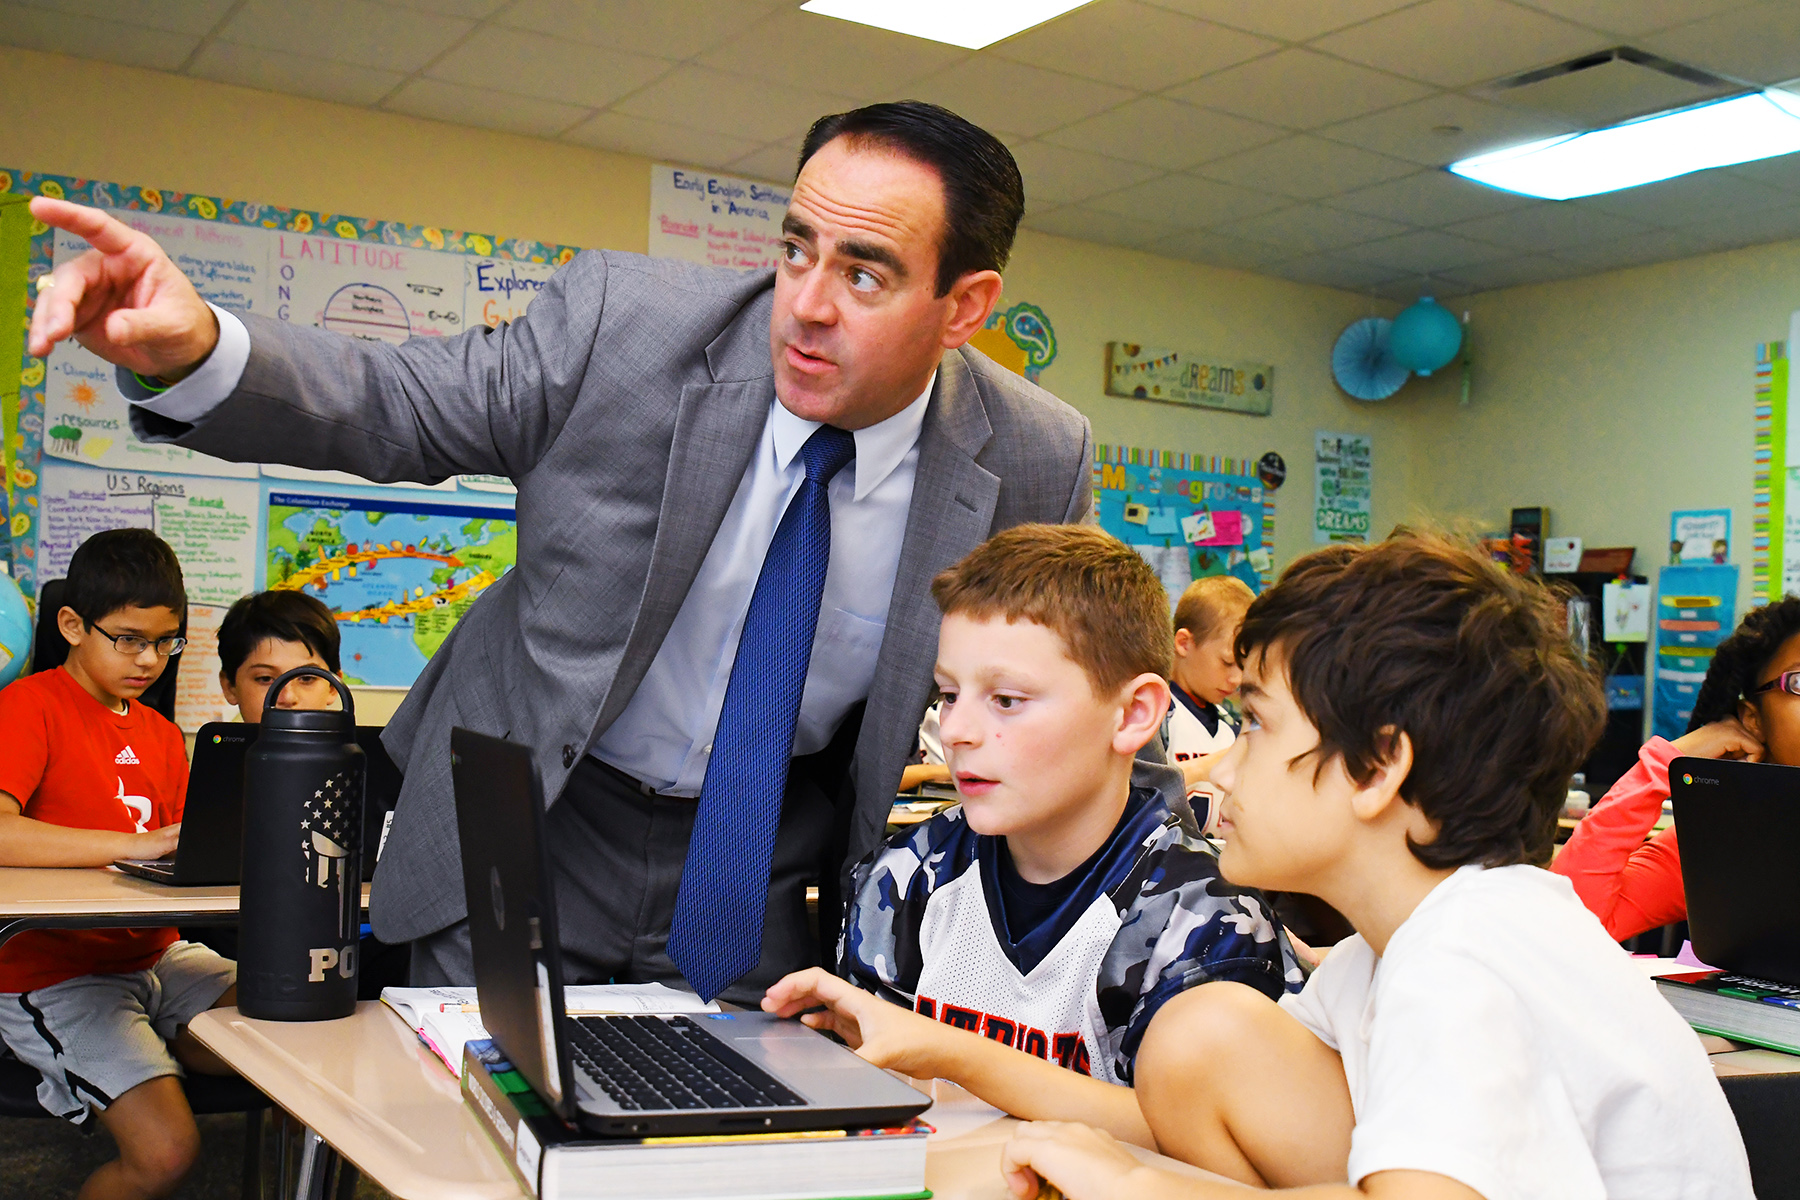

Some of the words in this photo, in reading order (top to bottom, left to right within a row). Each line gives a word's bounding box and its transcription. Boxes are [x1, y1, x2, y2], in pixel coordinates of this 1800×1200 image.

[279, 235, 407, 271] LATITUDE
[137, 476, 185, 500] Regions
[115, 757, 141, 765] adidas
[1694, 776, 1720, 786] chrome
